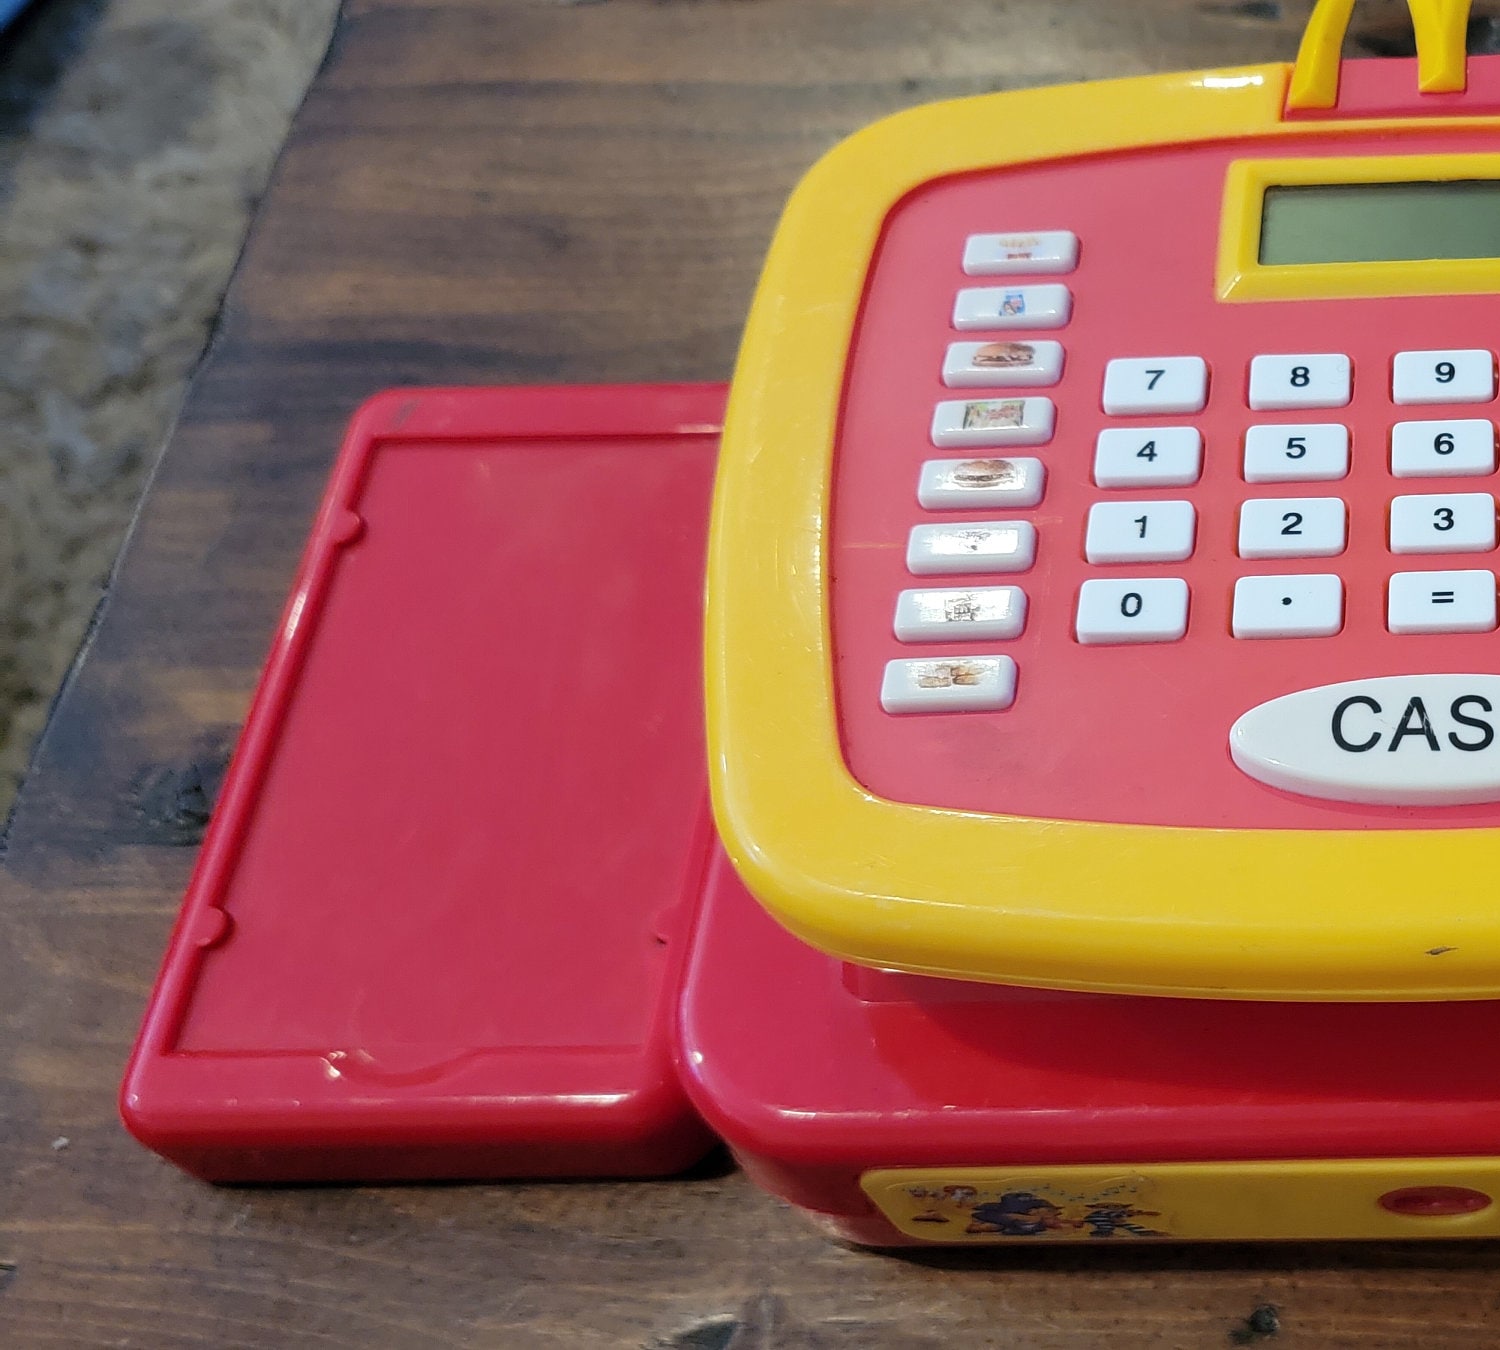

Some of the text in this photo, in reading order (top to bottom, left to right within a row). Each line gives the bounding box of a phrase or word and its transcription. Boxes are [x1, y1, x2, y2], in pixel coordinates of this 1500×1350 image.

[1145, 369, 1165, 391] 7
[1289, 366, 1310, 388] 8
[1434, 361, 1456, 384] 9
[1136, 440, 1158, 462] 4
[1285, 437, 1307, 459] 5
[1433, 432, 1455, 456] 6
[1134, 515, 1148, 539] 1
[1280, 512, 1303, 536] 2
[1433, 507, 1455, 532] 3
[1120, 592, 1143, 618] 0
